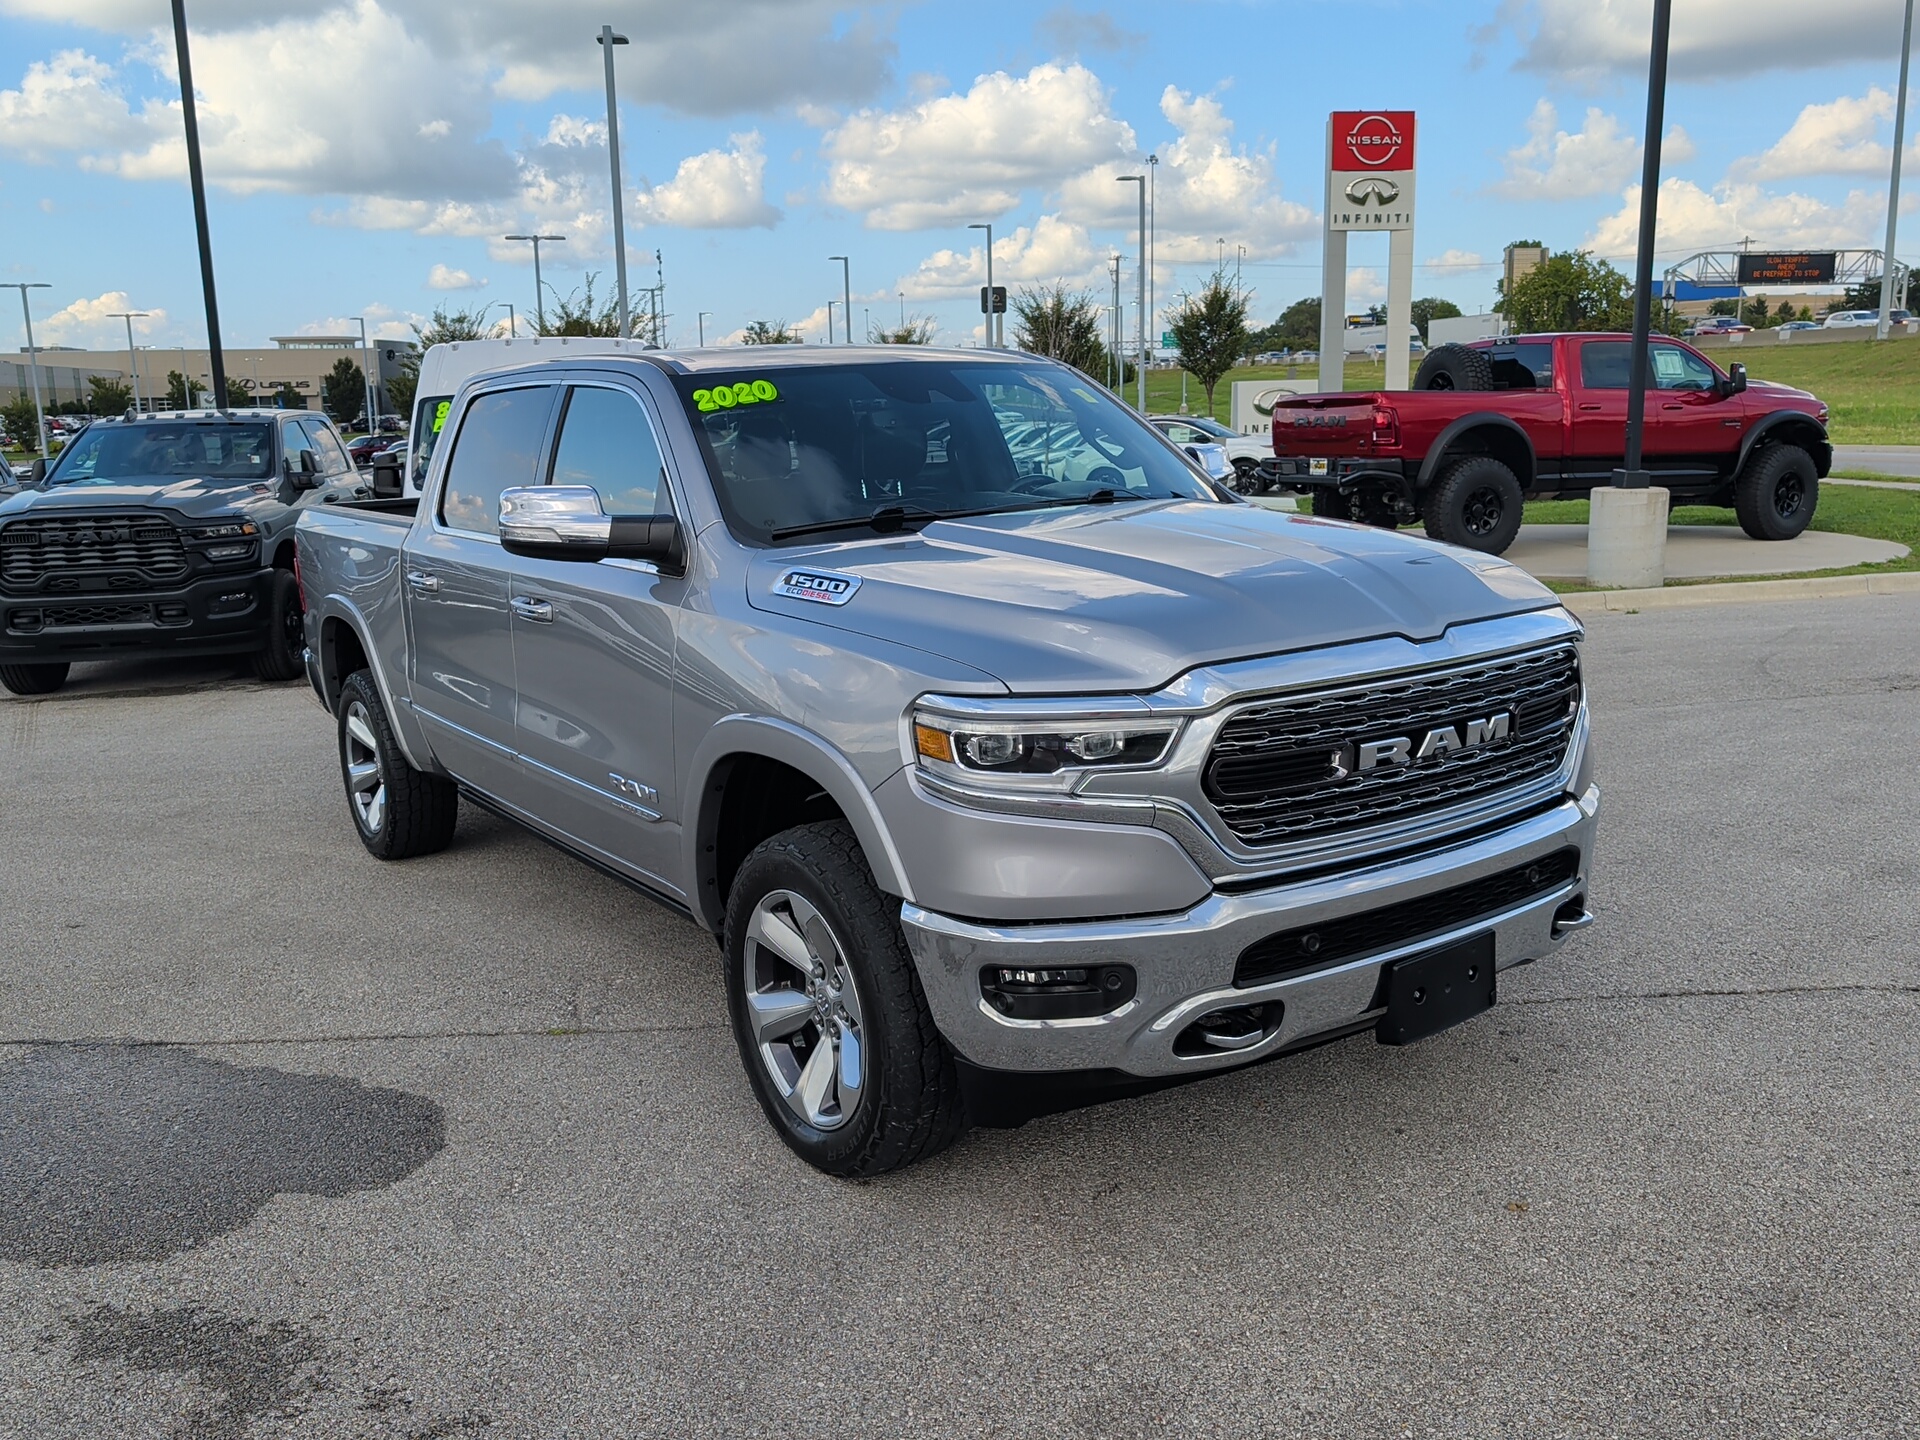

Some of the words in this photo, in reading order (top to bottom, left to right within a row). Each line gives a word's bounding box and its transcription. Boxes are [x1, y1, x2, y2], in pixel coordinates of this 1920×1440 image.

[1346, 135, 1402, 145] NISSAN
[1334, 213, 1410, 224] INFINITI
[1766, 256, 1782, 264] SLOW
[1753, 270, 1761, 278] BE
[1763, 270, 1792, 278] PREPARED
[1804, 269, 1820, 277] STOP
[260, 381, 310, 389] LEUS
[693, 380, 778, 412] 2020
[1294, 415, 1347, 428] RAM
[40, 529, 131, 544] RAM
[790, 574, 847, 593] 1500
[786, 586, 833, 601] ECODIESEL
[1359, 712, 1510, 771] RAM
[608, 772, 660, 804] RAM
